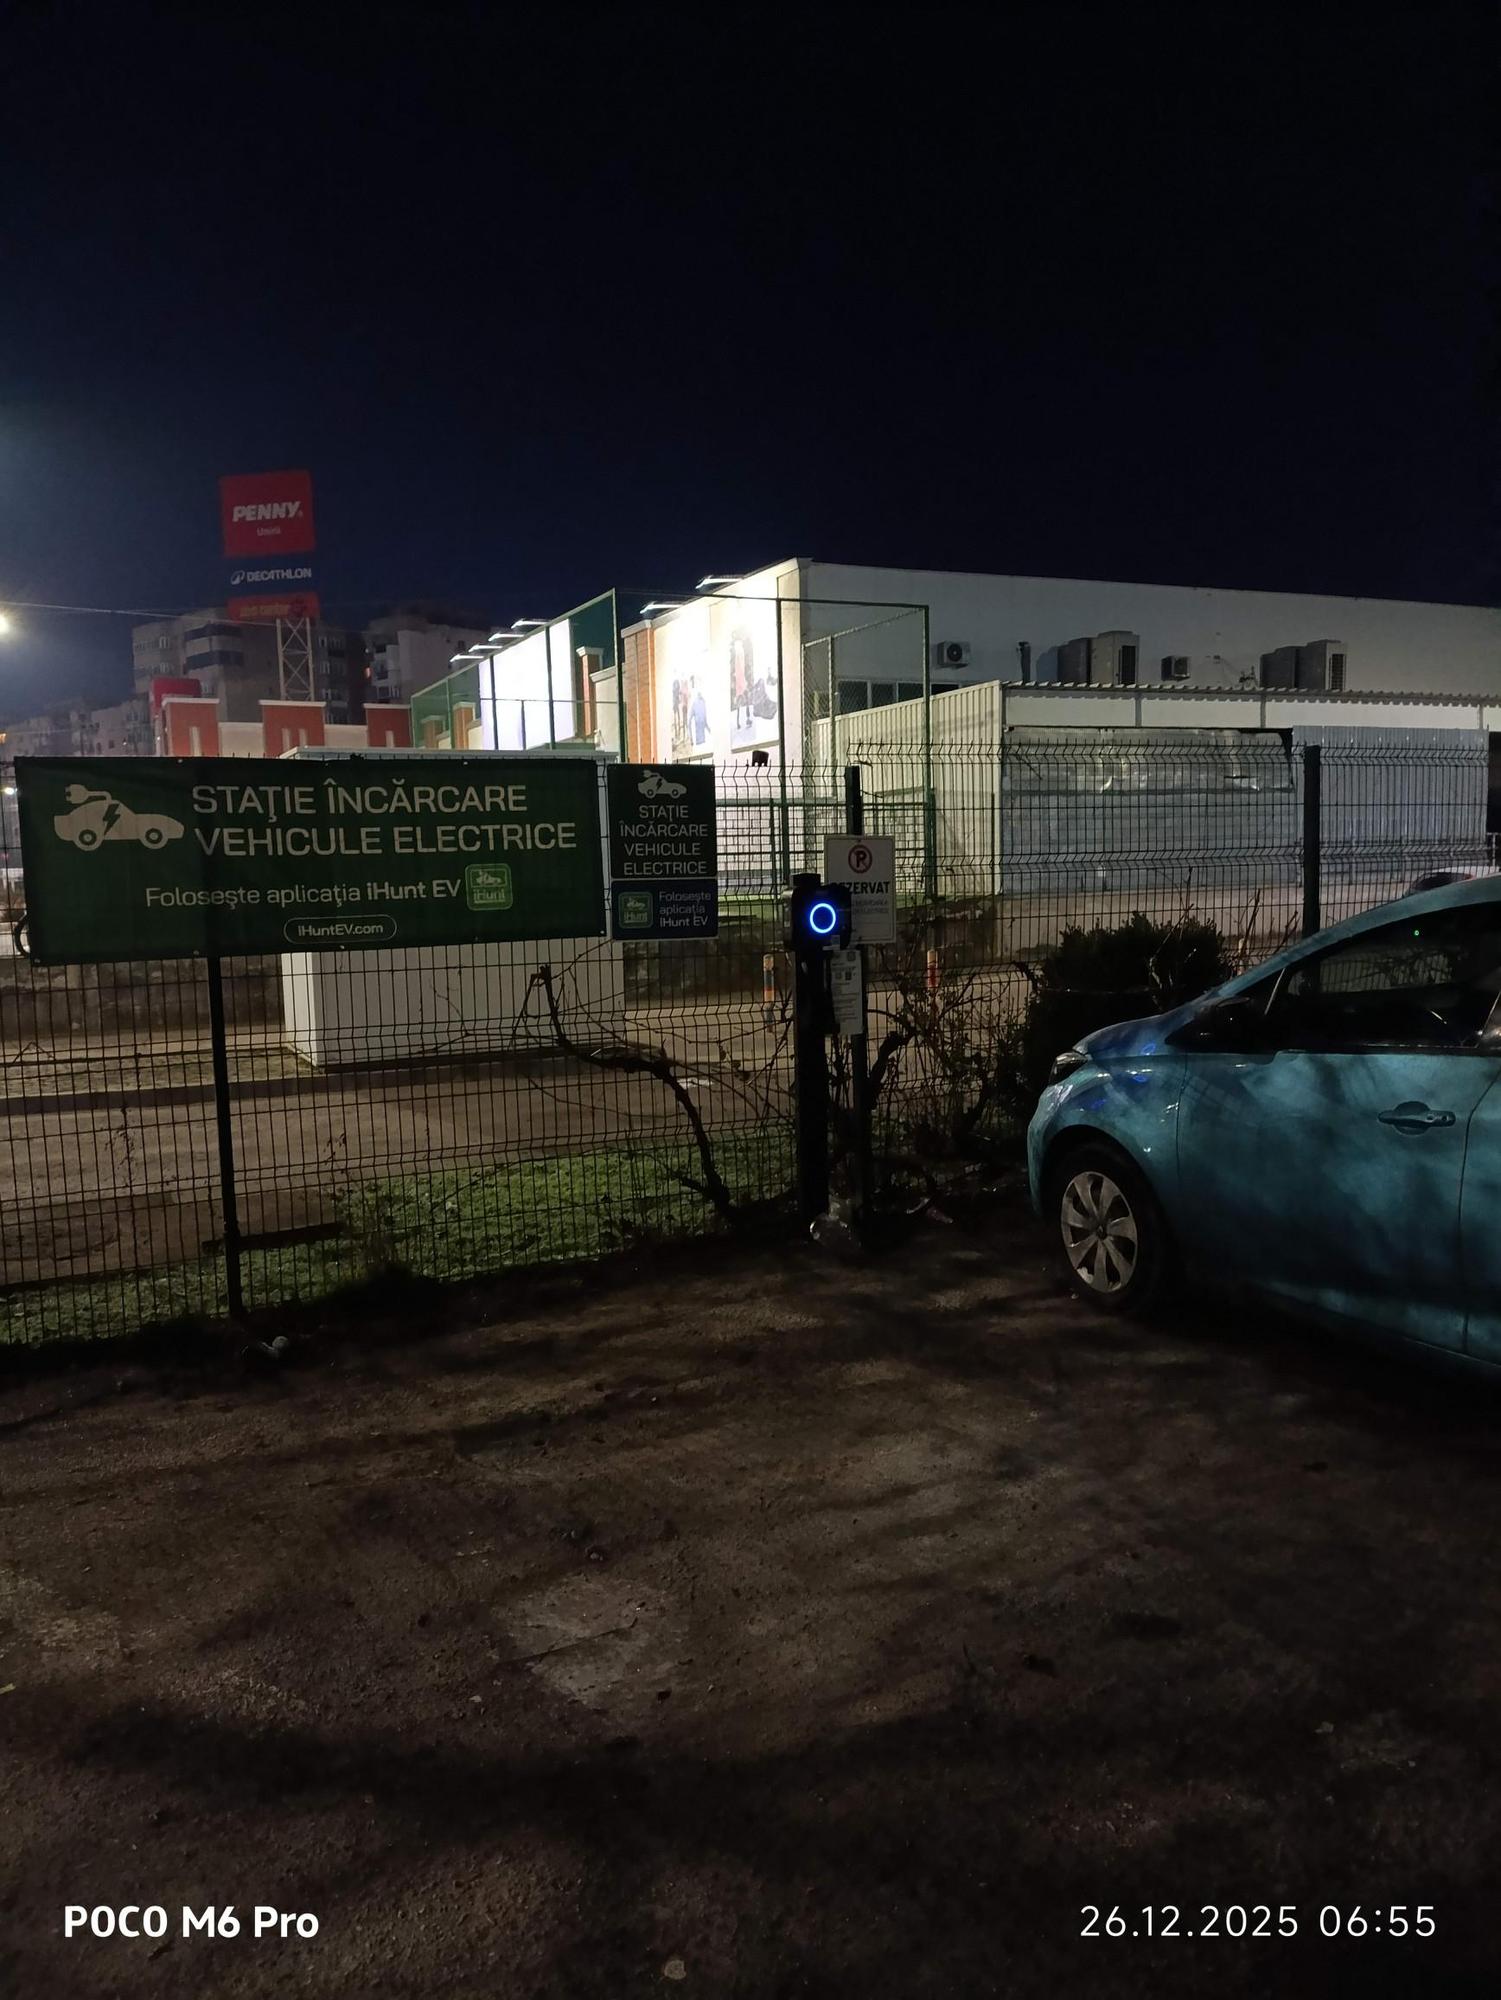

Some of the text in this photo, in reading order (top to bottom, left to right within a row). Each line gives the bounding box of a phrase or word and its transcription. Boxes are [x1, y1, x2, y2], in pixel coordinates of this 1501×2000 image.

[246, 567, 312, 583] DECATHLON
[324, 778, 528, 814] ÎNCĂRCARE
[620, 820, 708, 837] ÎNCĂRCARE
[195, 822, 577, 856] VEHICULE ELECTRICE
[624, 842, 701, 857] VEHICULE
[623, 861, 708, 876] ELECTRICE
[366, 881, 427, 901] iHunt
[432, 879, 461, 898] EV
[473, 888, 506, 903] iHunt
[831, 881, 890, 895] ZERVAT
[693, 915, 708, 927] EV
